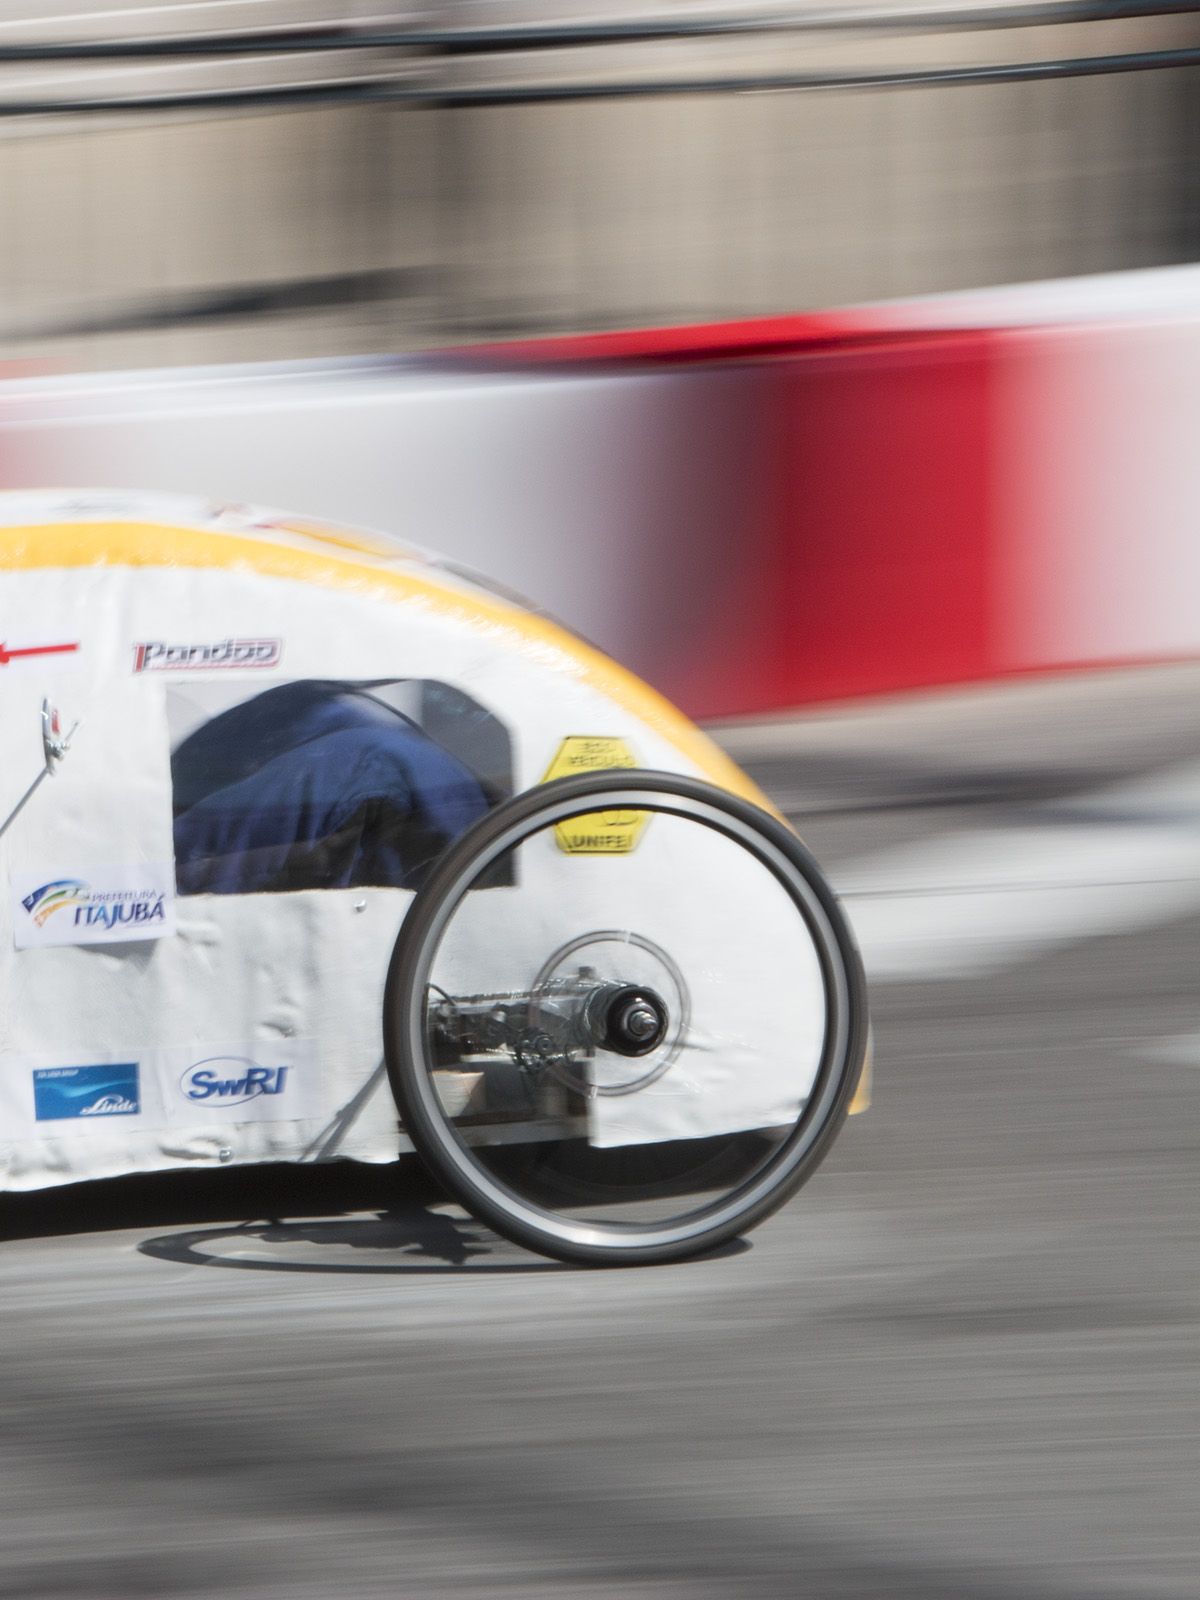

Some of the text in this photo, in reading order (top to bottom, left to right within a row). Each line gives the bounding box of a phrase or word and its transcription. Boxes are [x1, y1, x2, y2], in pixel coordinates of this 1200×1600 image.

[570, 834, 633, 849] UNIFEI
[74, 894, 166, 929] ITAJUBÁ
[188, 1066, 289, 1099] SwRI
